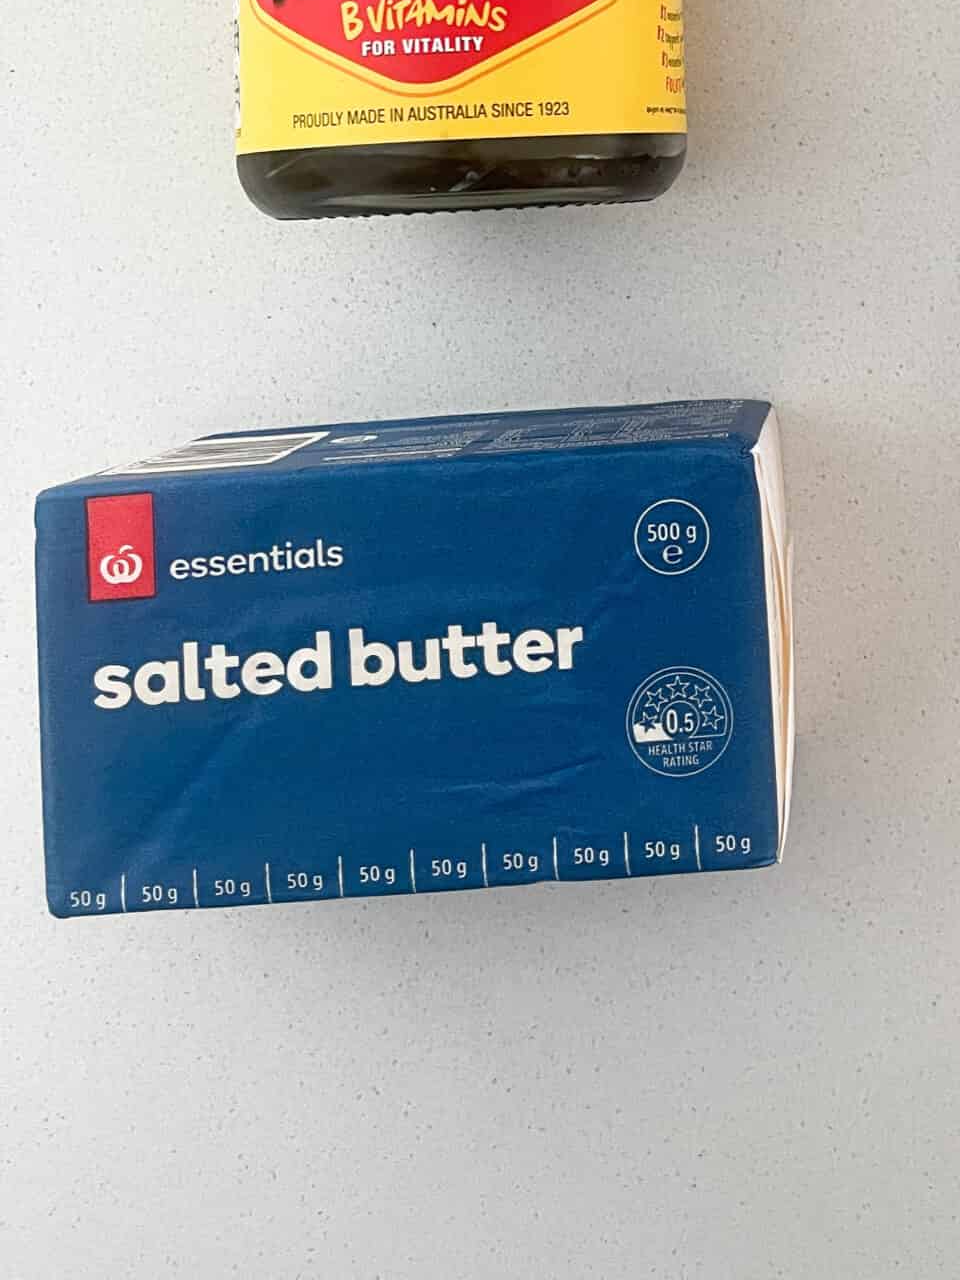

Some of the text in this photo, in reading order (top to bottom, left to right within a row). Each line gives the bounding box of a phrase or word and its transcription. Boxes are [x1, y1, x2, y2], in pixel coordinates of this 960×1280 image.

[340, 0, 364, 40] B
[361, 36, 483, 57] FOR VITALITY
[293, 100, 570, 129] PROUDLY MADE IN AUSTRALIA SINCE 1923
[647, 522, 697, 544] 500 g
[169, 538, 344, 580] essentials
[93, 620, 585, 710] salted butter
[666, 709, 695, 734] 0.5
[648, 740, 713, 756] HEALTH STAR
[663, 754, 700, 768] RATING
[644, 841, 681, 859] 50 g
[715, 835, 751, 854] 50 g
[503, 853, 539, 872] 50 g
[574, 847, 609, 866] 50 g
[359, 866, 396, 884] 50 g
[431, 859, 467, 877] 50 g
[214, 879, 251, 897] 50 g
[287, 872, 324, 890] 50 g
[70, 890, 106, 910] 50 g
[142, 885, 178, 904] 50 g
